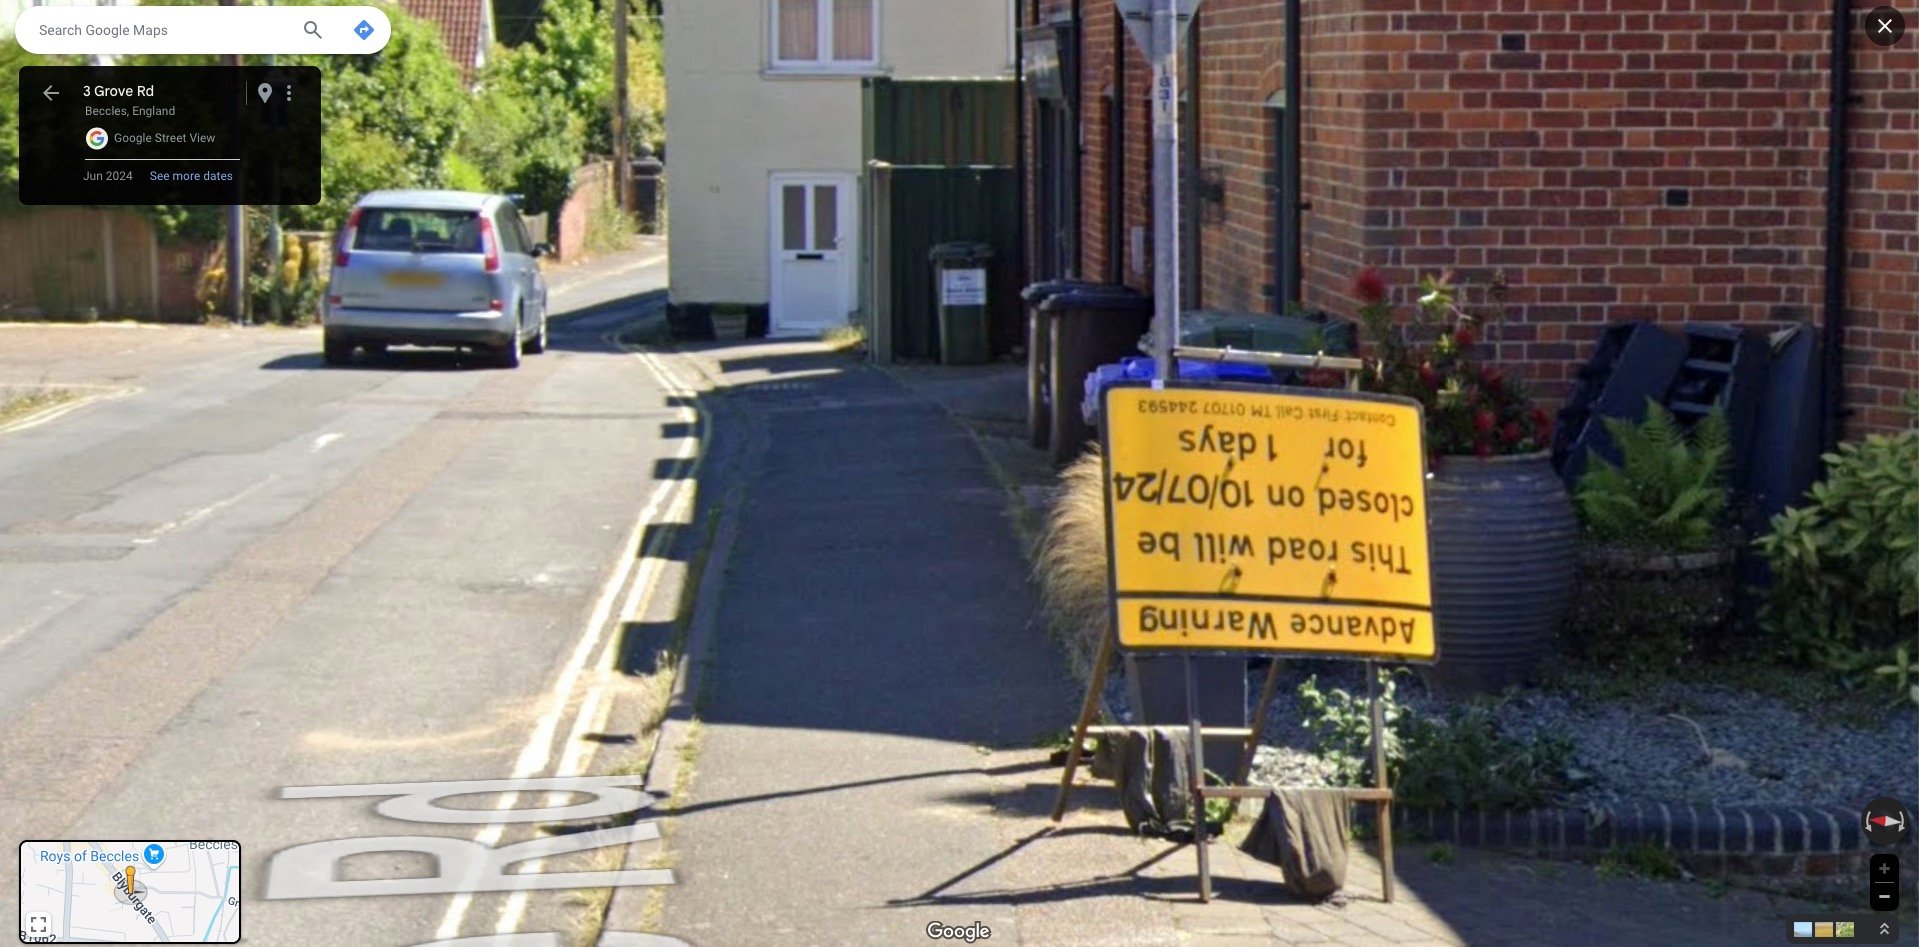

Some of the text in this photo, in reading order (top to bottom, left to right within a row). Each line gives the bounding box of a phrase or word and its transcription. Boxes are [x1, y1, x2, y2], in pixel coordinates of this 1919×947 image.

[1138, 401, 1396, 427] Contact First Call TM 01707 244593
[1179, 425, 1367, 467] for 1 days
[1114, 468, 1414, 521] closed on 10/07/24
[1137, 531, 1413, 575] This road will be
[1139, 606, 1416, 644] Advance Warning
